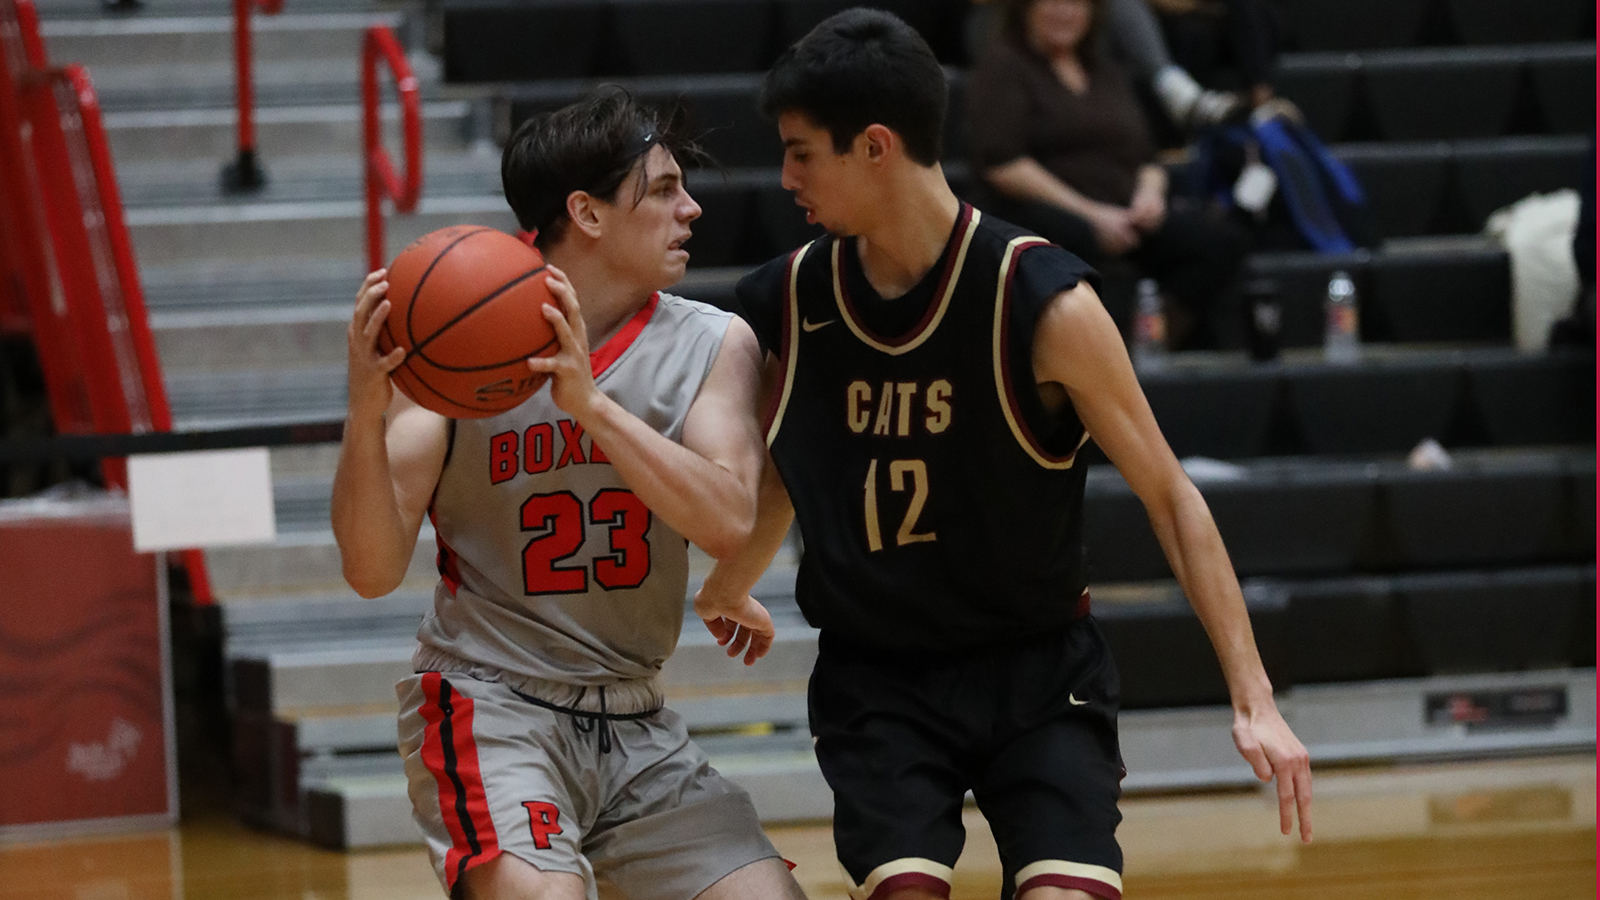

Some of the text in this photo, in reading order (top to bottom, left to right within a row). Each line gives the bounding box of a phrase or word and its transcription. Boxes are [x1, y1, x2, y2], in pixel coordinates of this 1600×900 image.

[847, 378, 953, 437] CATS
[520, 488, 652, 596] 23
[863, 458, 937, 552] 12
[521, 800, 563, 850] P
